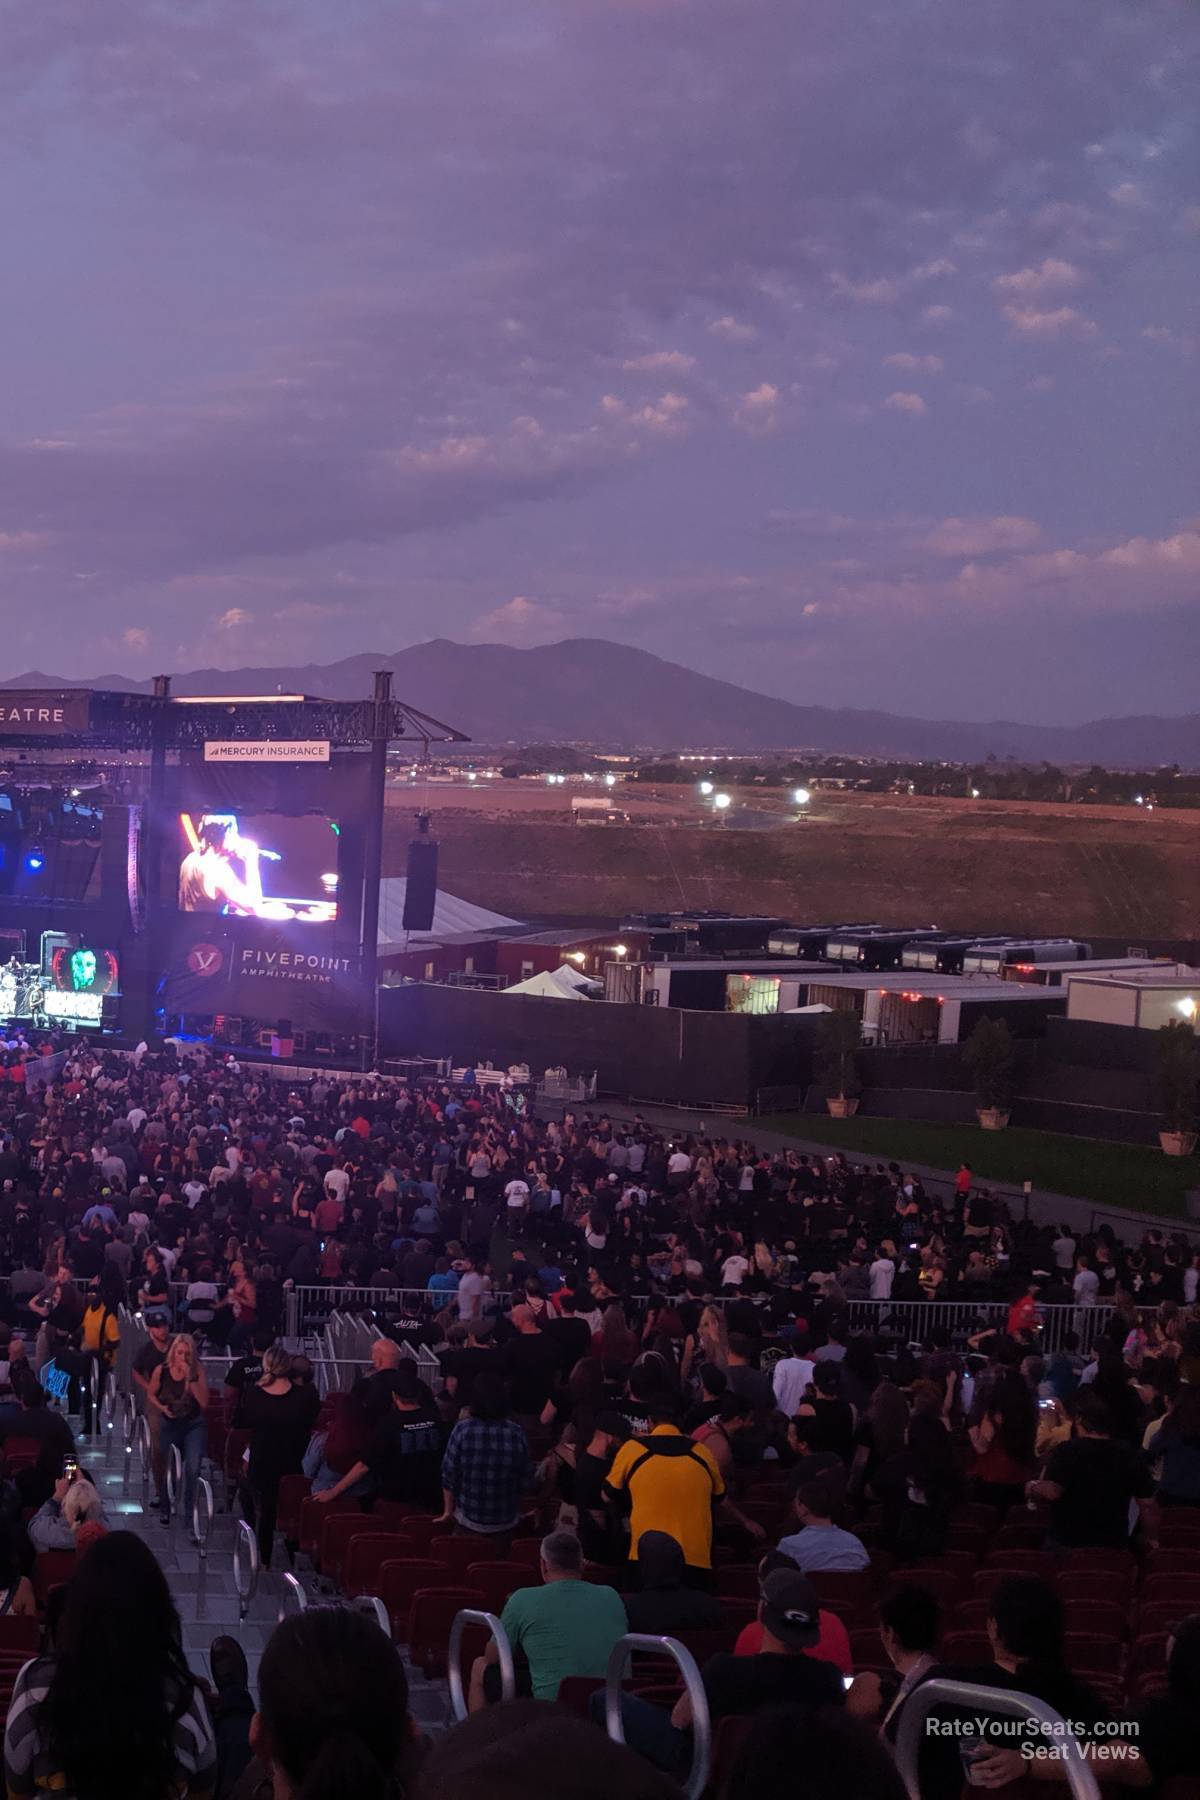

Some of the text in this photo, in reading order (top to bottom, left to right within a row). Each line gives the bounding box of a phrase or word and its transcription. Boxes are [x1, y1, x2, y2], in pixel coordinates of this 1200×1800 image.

[220, 747, 325, 755] MERCURY INSURANCE
[242, 950, 351, 972] FIVEPOINT
